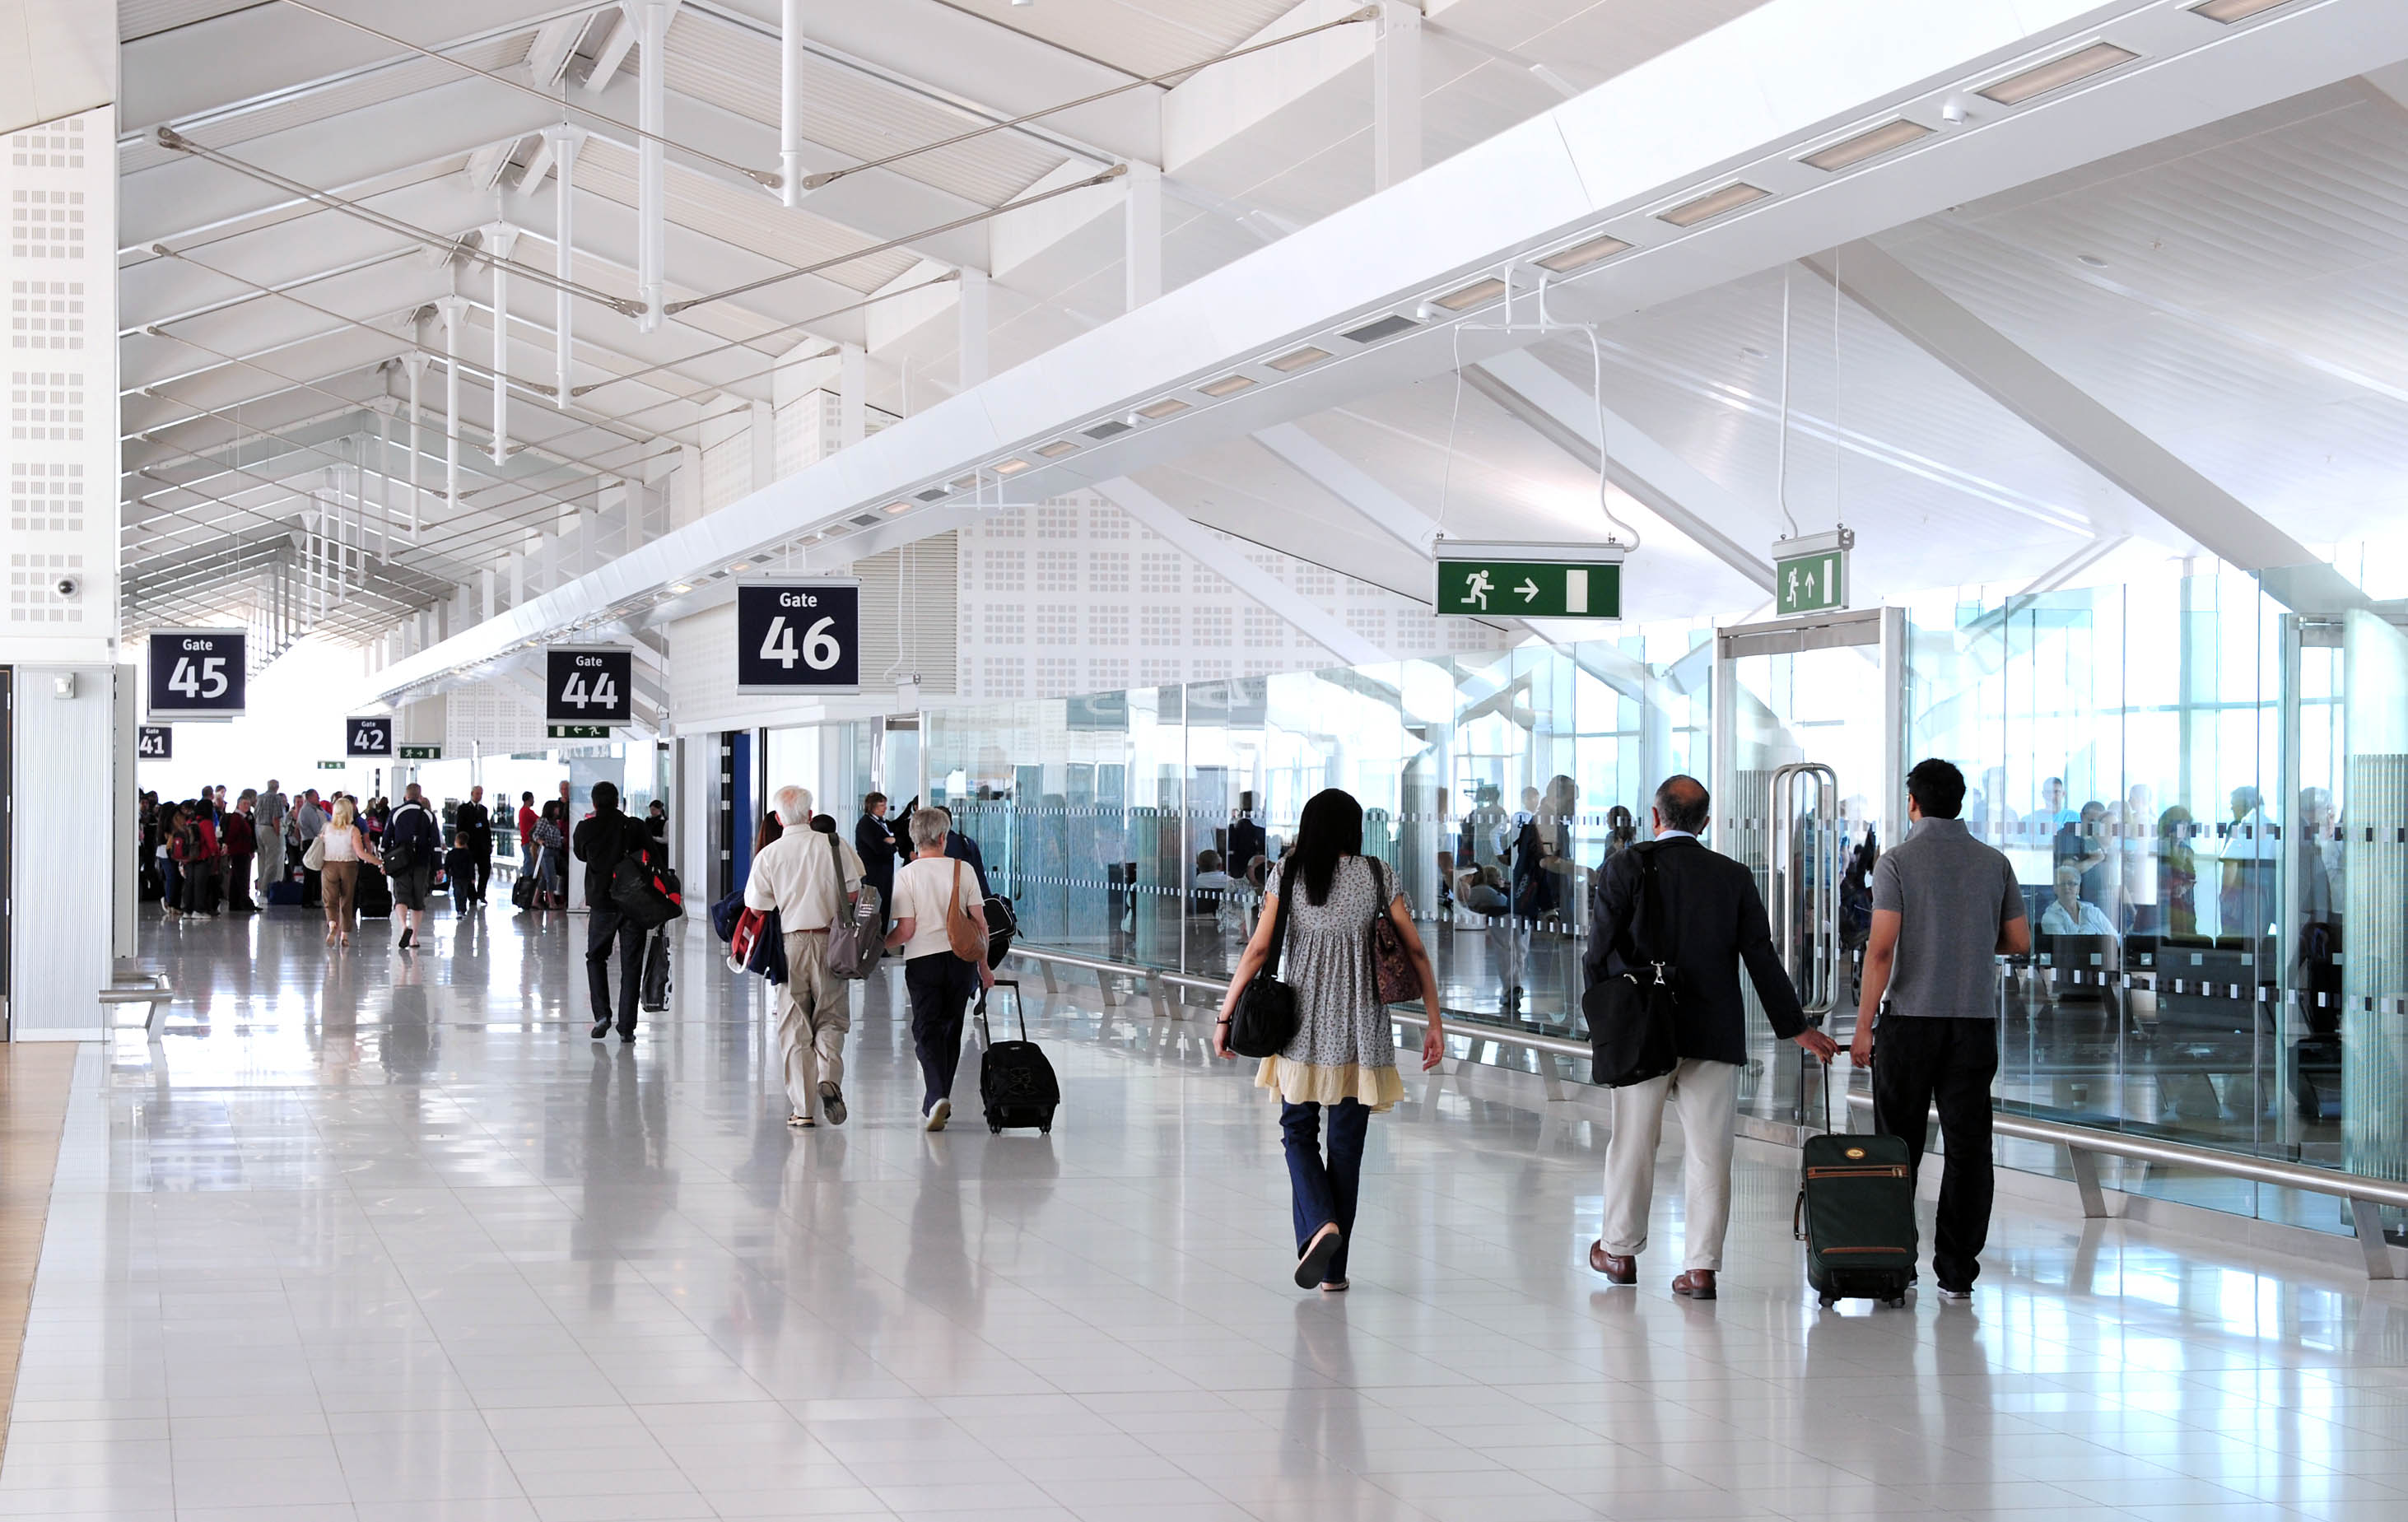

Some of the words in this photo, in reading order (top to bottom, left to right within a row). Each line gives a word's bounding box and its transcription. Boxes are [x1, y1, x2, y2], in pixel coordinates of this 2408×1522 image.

[779, 592, 817, 607] Gate
[182, 638, 213, 651] Gate
[759, 616, 841, 671] 46
[575, 655, 603, 668] Gate
[168, 657, 228, 699] 45
[561, 672, 618, 710] 44
[139, 735, 165, 754] 41
[354, 729, 384, 750] 42
